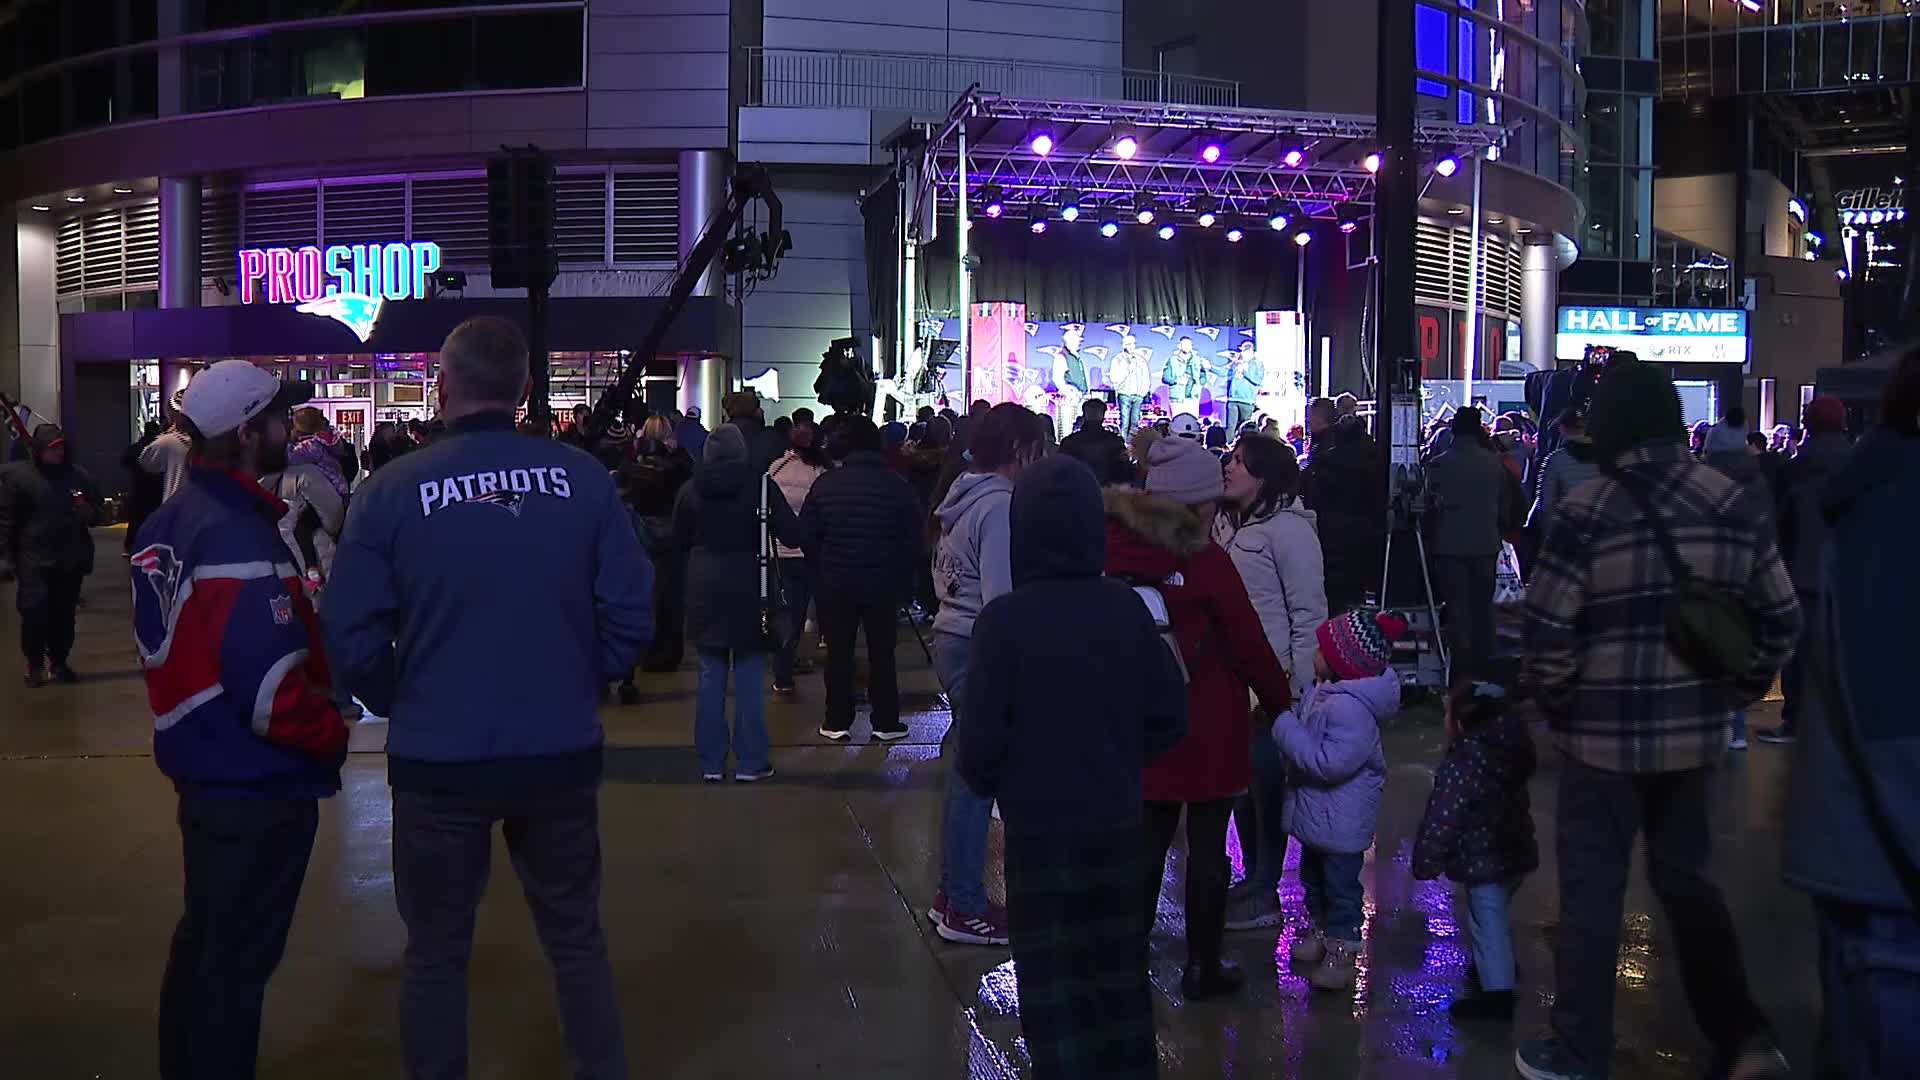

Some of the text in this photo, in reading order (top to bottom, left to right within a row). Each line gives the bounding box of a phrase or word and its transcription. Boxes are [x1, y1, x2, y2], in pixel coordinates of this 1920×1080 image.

[239, 241, 441, 304] PRO SHOP
[1567, 309, 1645, 331] HALL
[1661, 312, 1738, 332] FAME
[1668, 345, 1691, 355] RTX
[342, 411, 361, 423] EXIT
[419, 467, 572, 517] PATRIOTS
